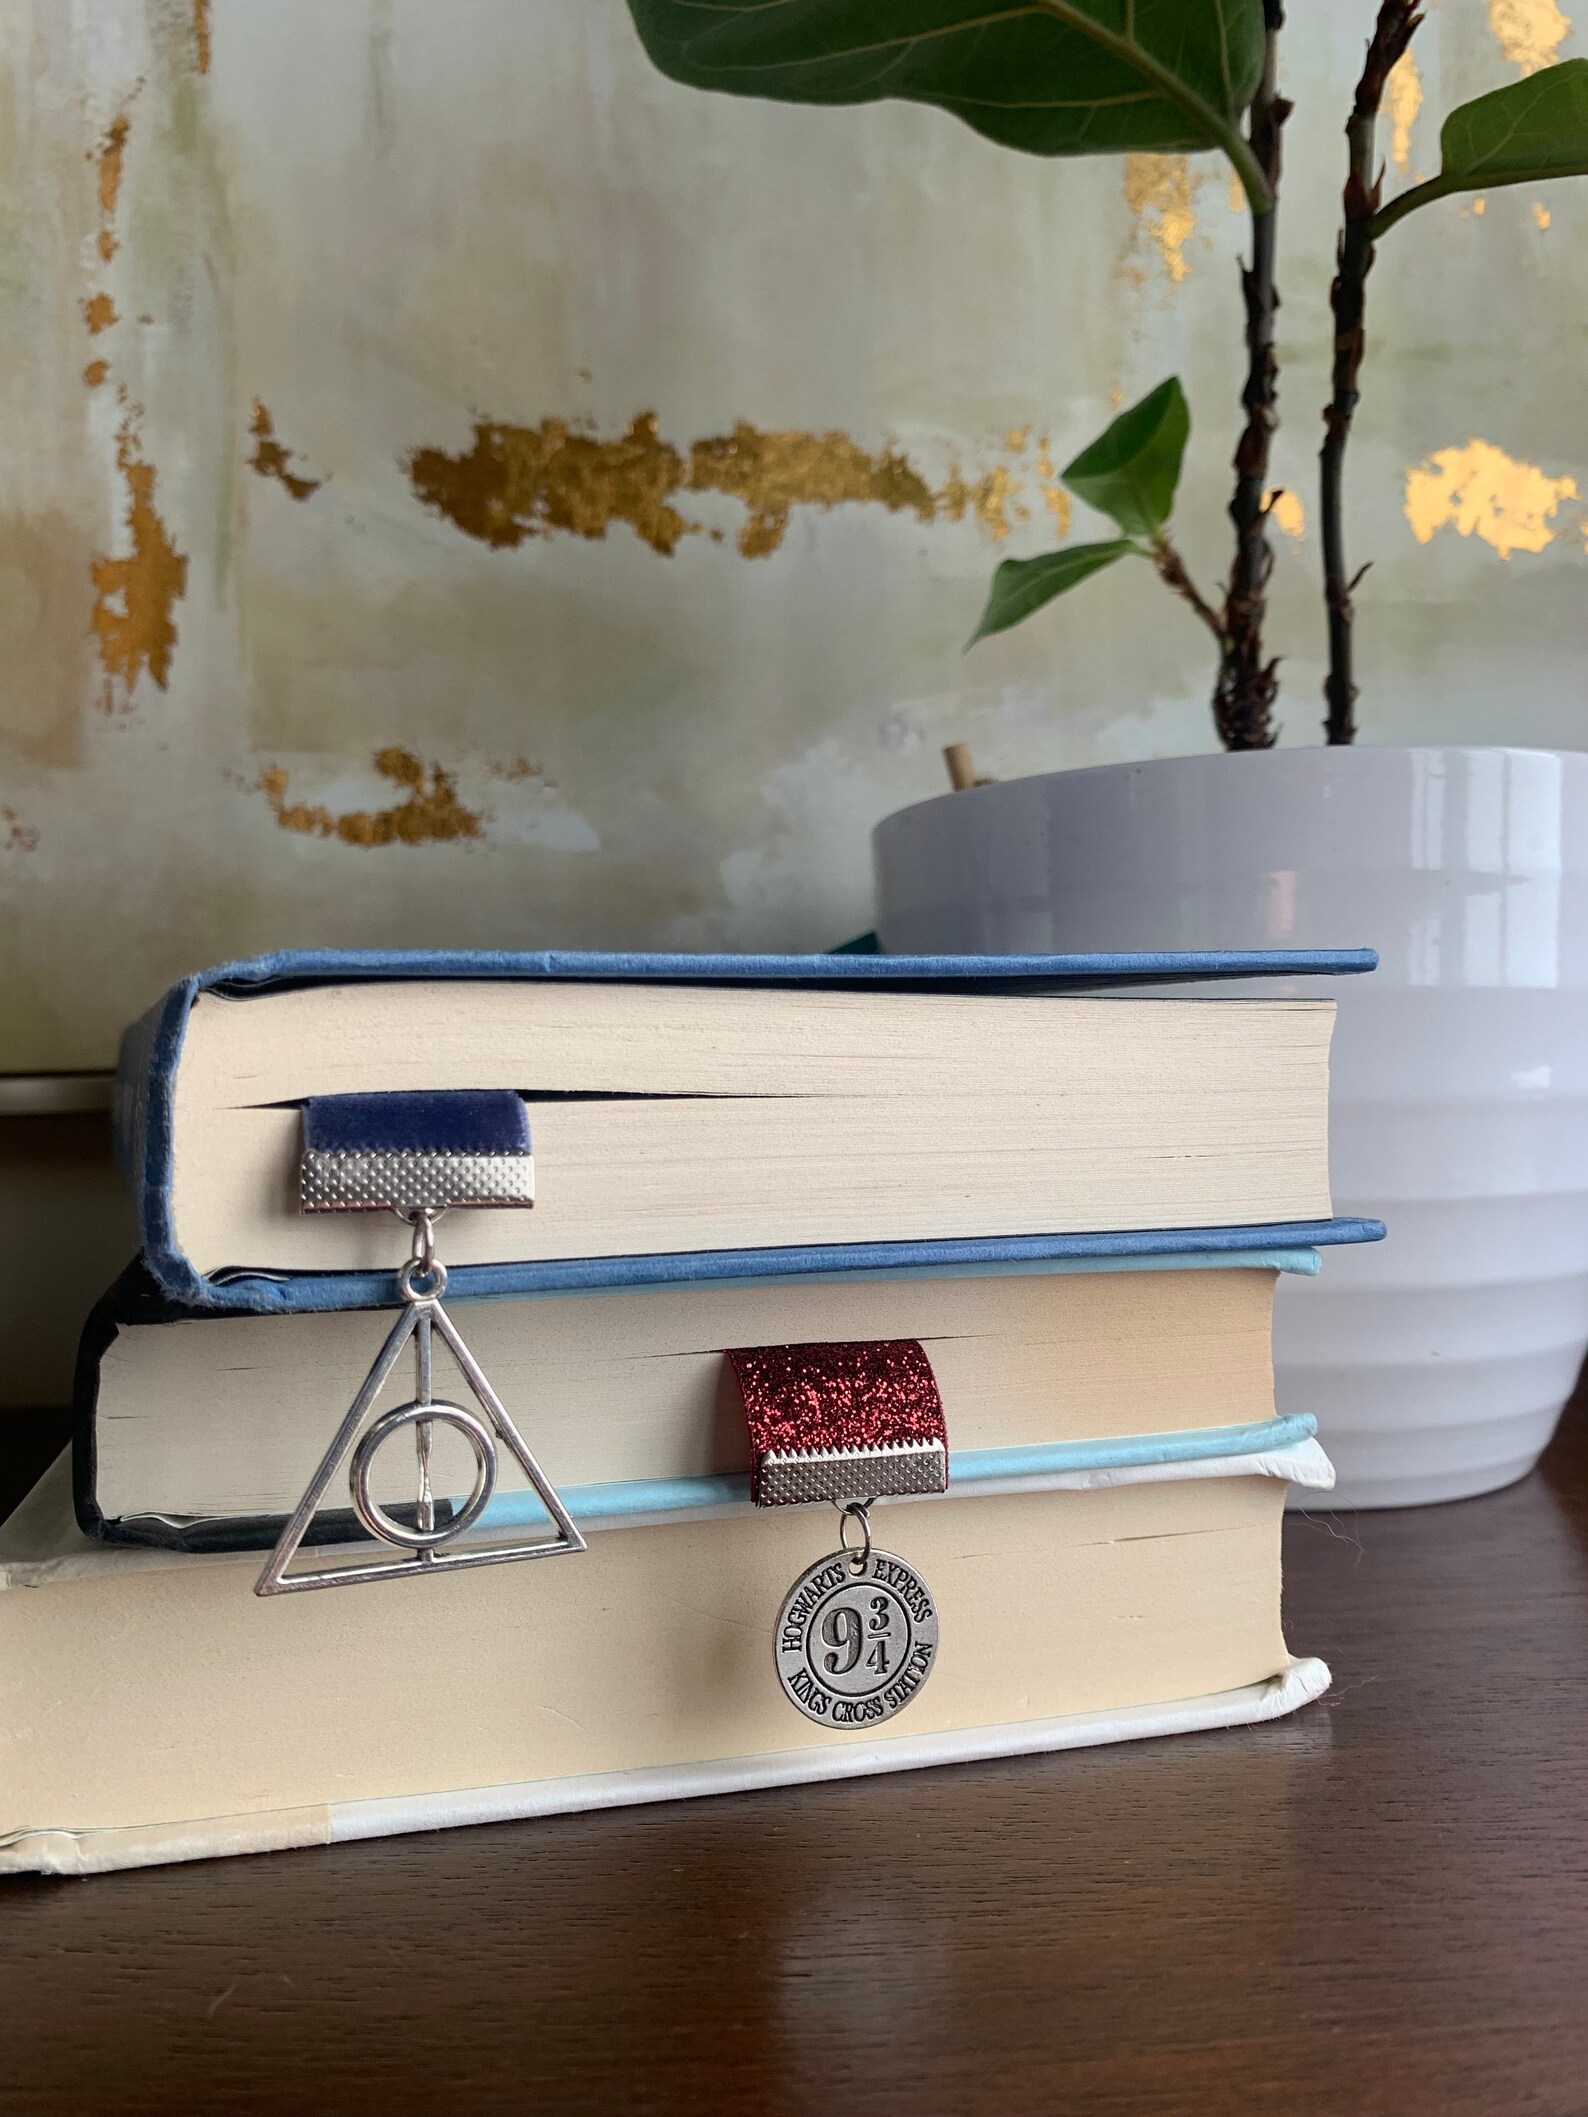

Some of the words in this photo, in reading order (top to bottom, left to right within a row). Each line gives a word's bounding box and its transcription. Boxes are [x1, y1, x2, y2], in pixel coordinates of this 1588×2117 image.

[782, 1562, 847, 1653] HOGWARTS
[872, 1558, 933, 1624] EXPRESS
[787, 1667, 832, 1715] KINGS
[831, 1695, 884, 1723] CROSS
[883, 1640, 934, 1709] STATION
